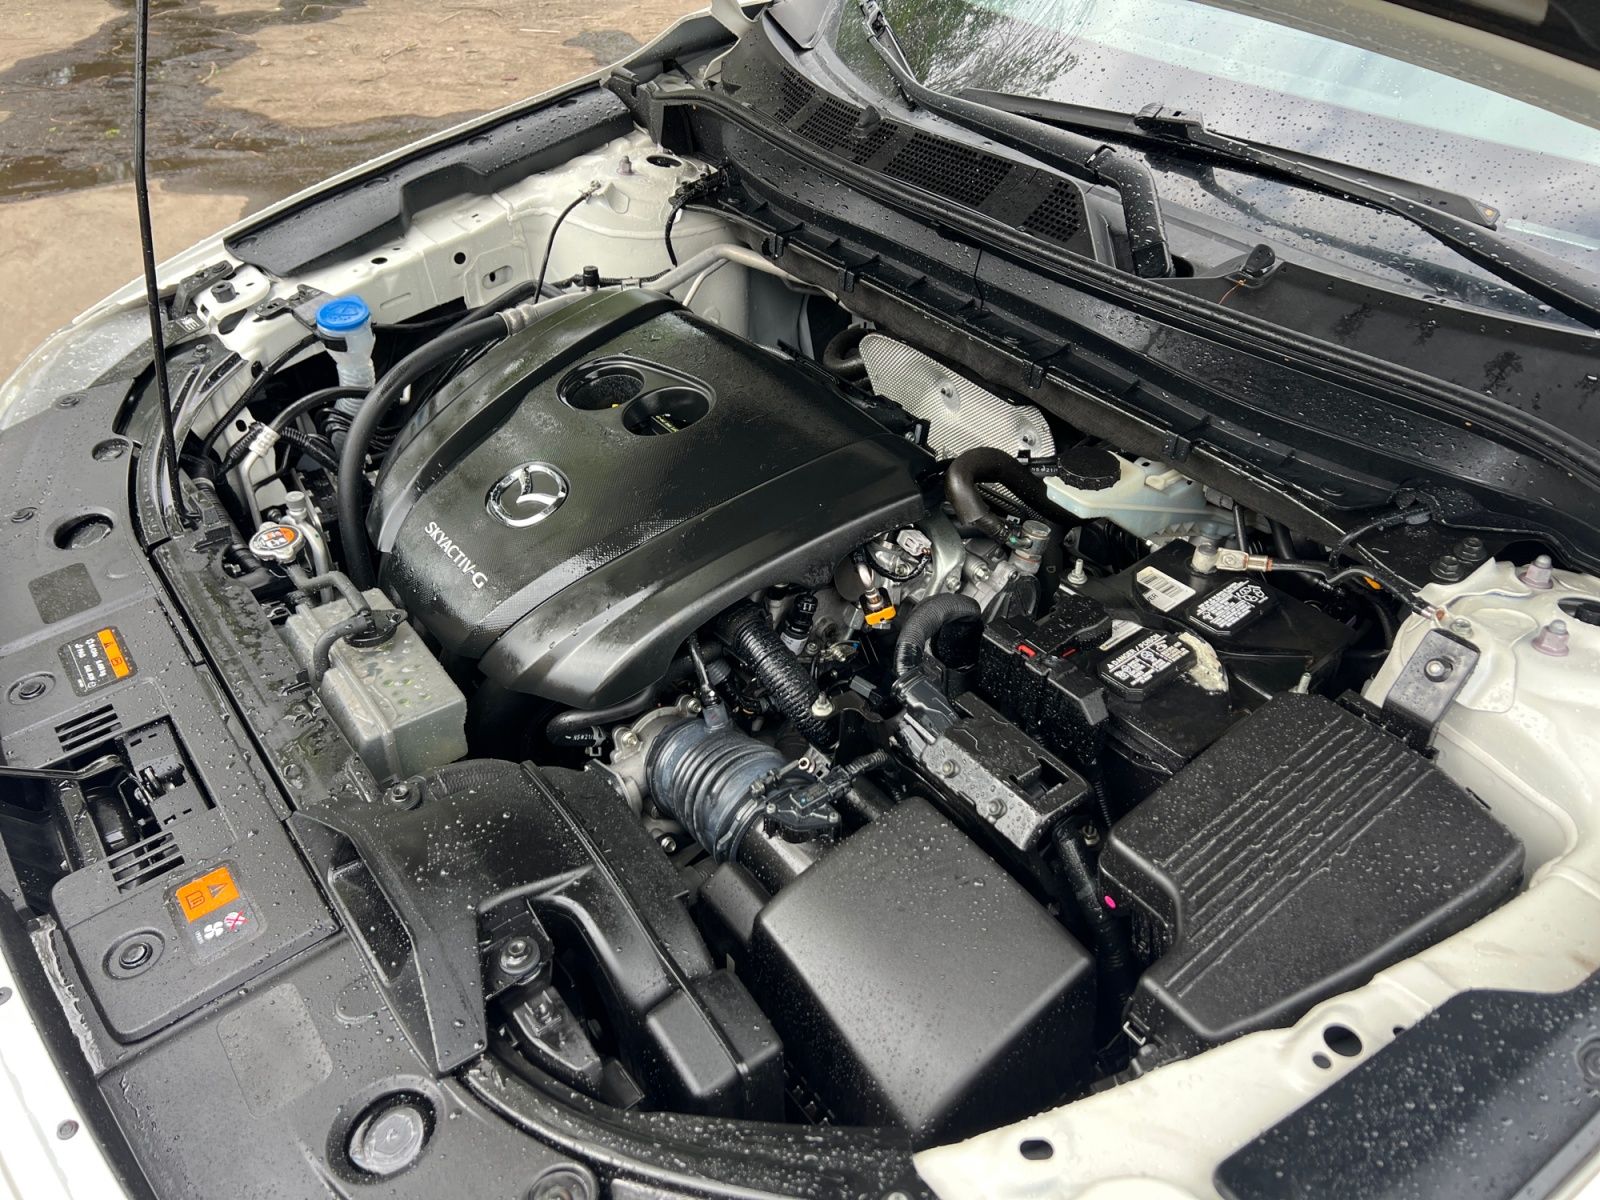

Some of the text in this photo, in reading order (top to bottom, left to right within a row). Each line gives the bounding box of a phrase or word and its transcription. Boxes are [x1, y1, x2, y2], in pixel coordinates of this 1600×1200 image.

[424, 521, 488, 589] SKYACTIV-G
[1111, 648, 1137, 666] DANGER
[1138, 633, 1162, 649] POISON
